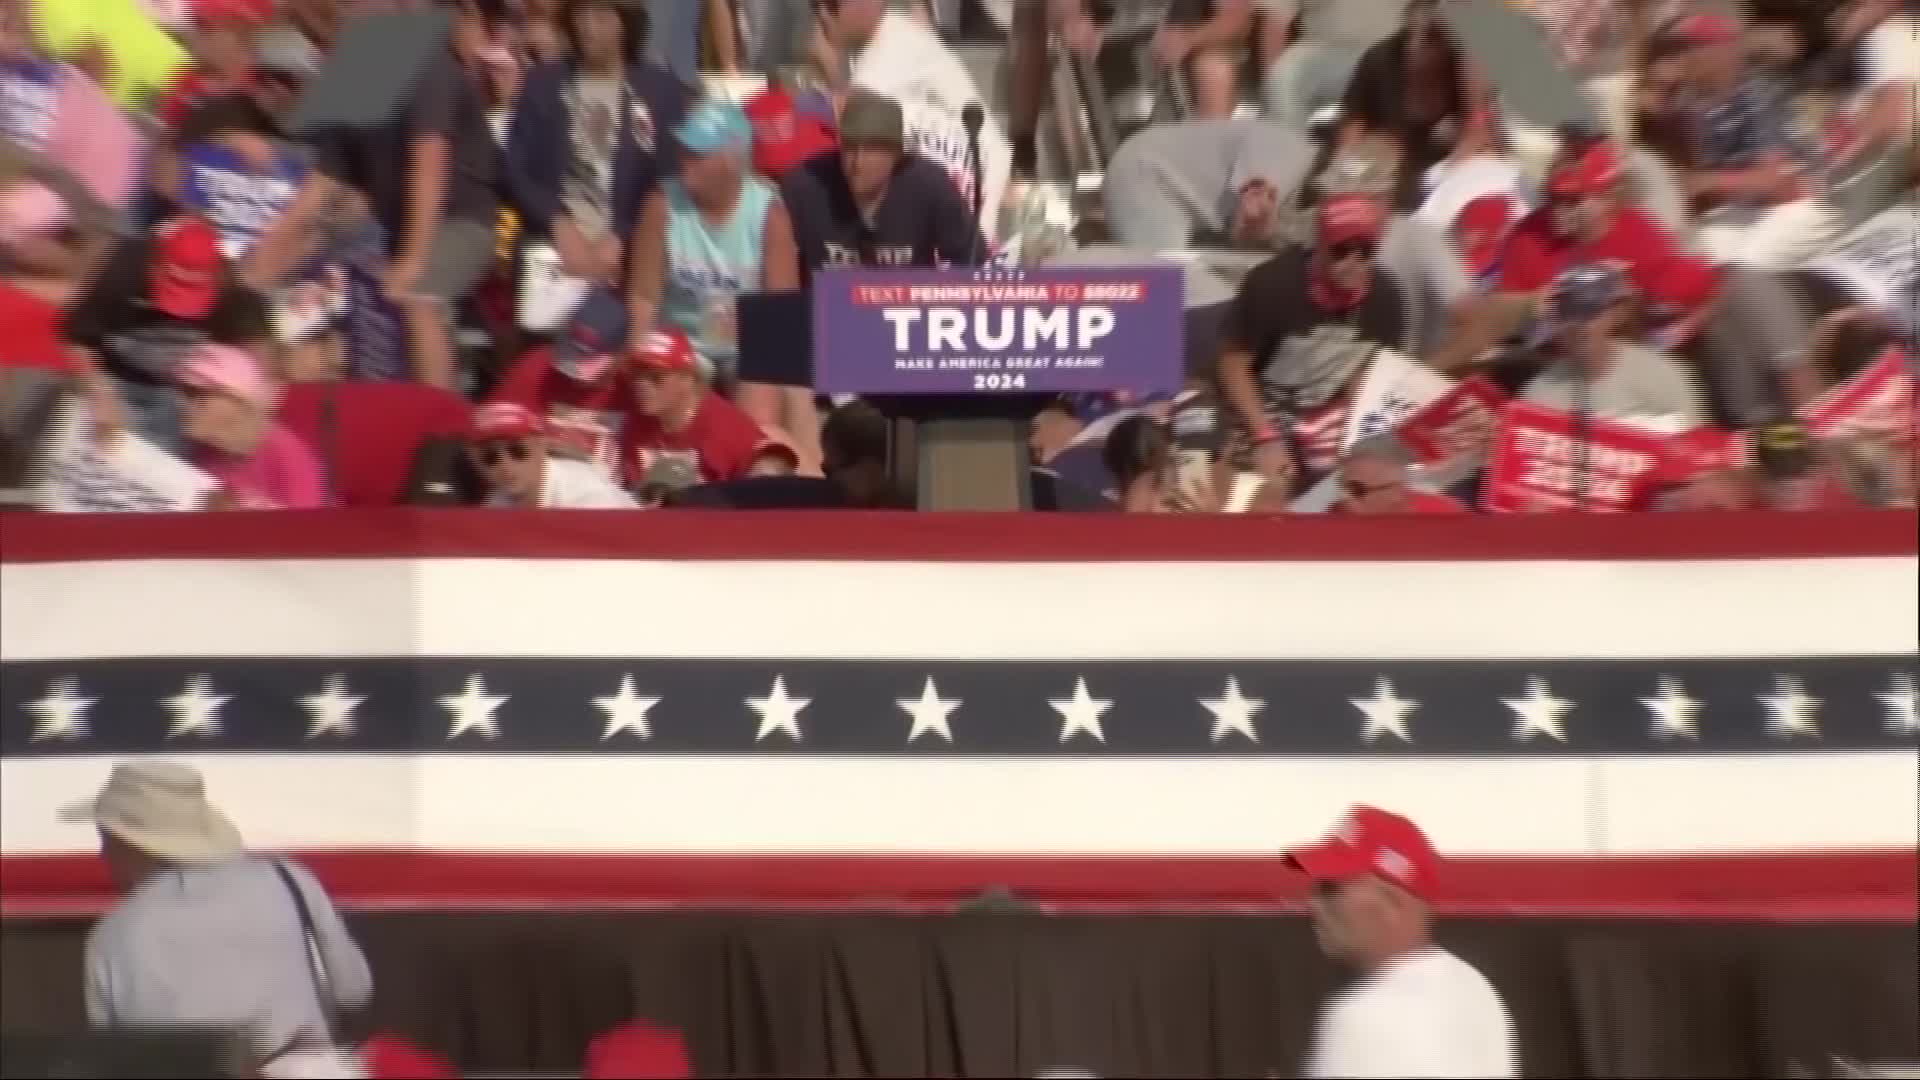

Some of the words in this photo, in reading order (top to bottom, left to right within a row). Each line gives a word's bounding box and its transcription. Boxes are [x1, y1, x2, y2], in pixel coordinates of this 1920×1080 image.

[859, 286, 904, 302] TEXT
[910, 284, 1049, 302] PENNSYLVANIA
[1056, 284, 1080, 301] TO
[883, 306, 1117, 351] TRUMP
[894, 357, 934, 369] MAKE
[939, 357, 1001, 369] AMERICA
[1006, 356, 1051, 369] GREAT
[1055, 356, 1104, 369] AGAIN!
[973, 373, 1026, 389] 2024
